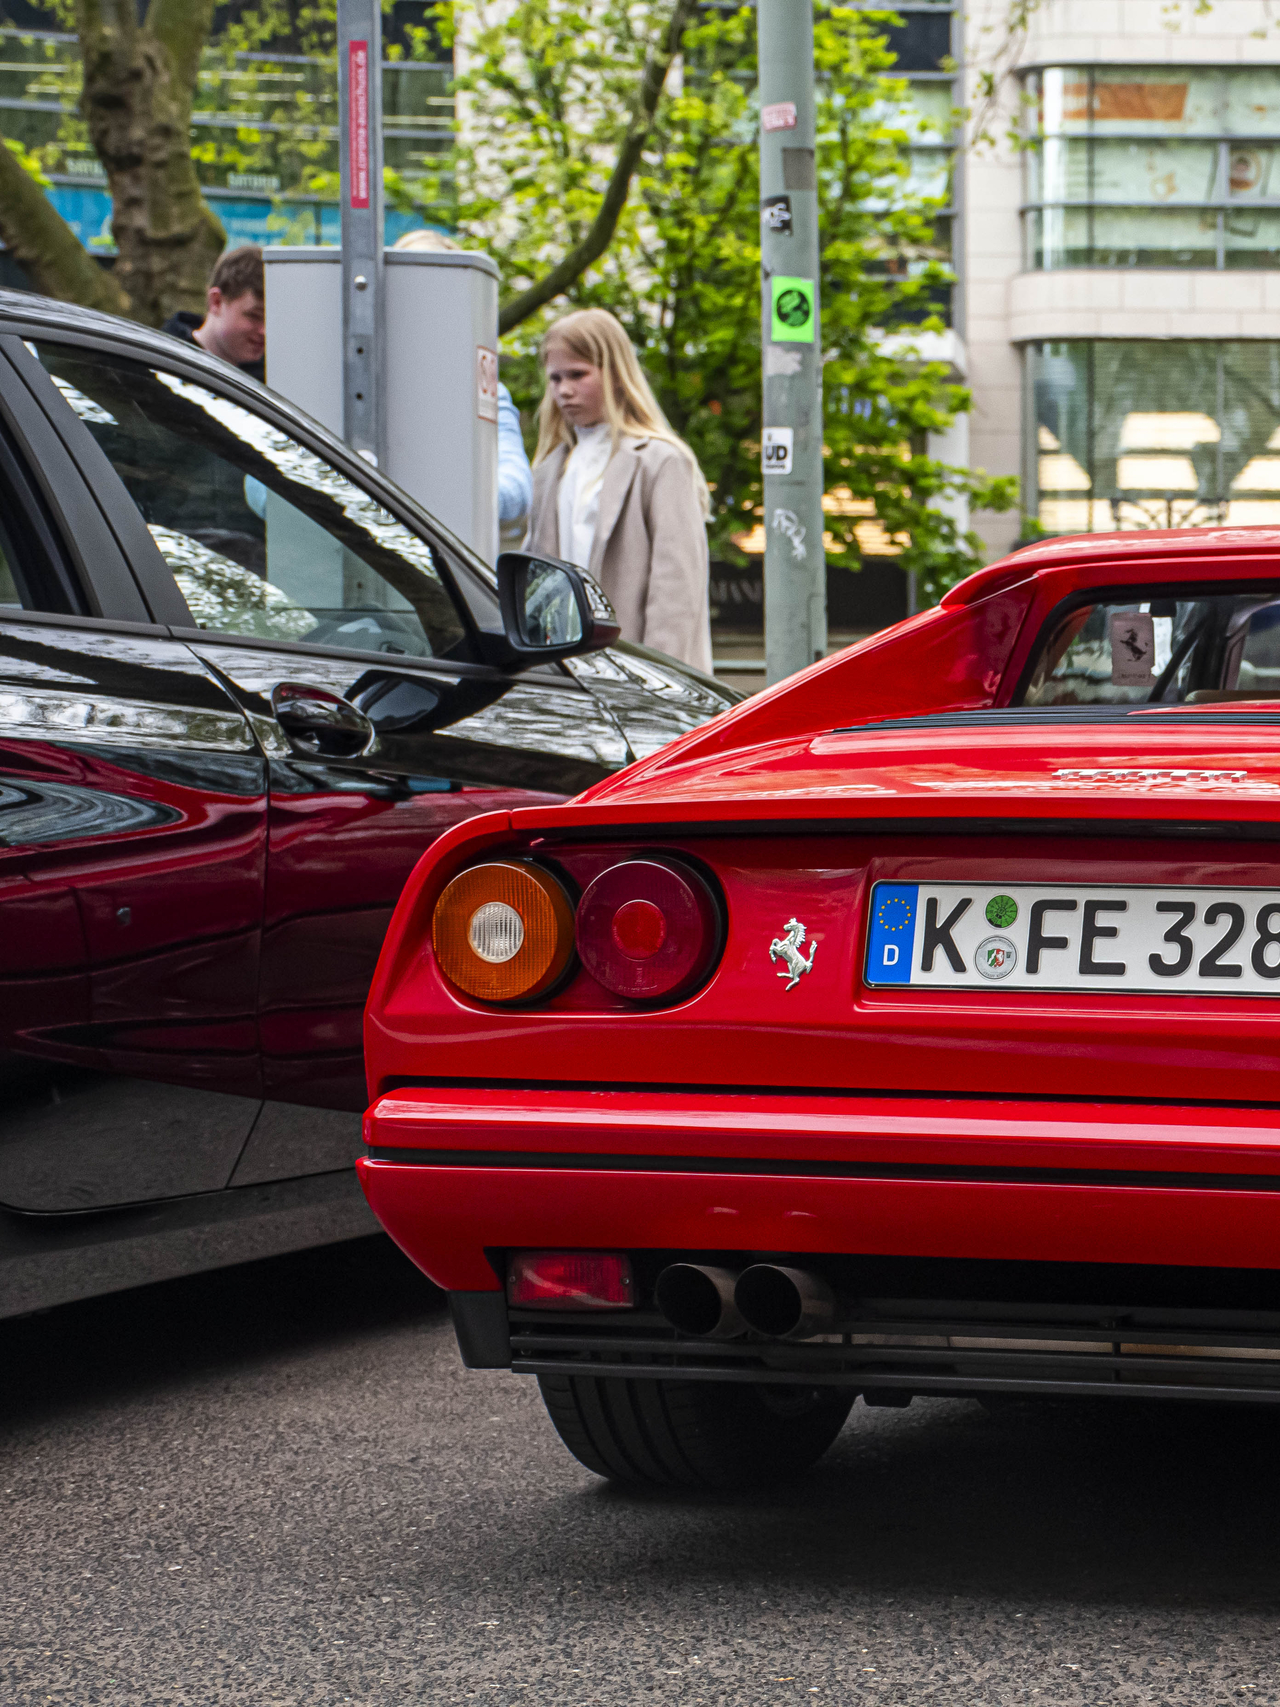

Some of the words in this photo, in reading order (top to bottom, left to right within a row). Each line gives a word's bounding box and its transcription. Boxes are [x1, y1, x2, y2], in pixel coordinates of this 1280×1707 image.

[883, 943, 899, 966] D
[920, 897, 973, 973] K
[1025, 899, 1128, 977] FE
